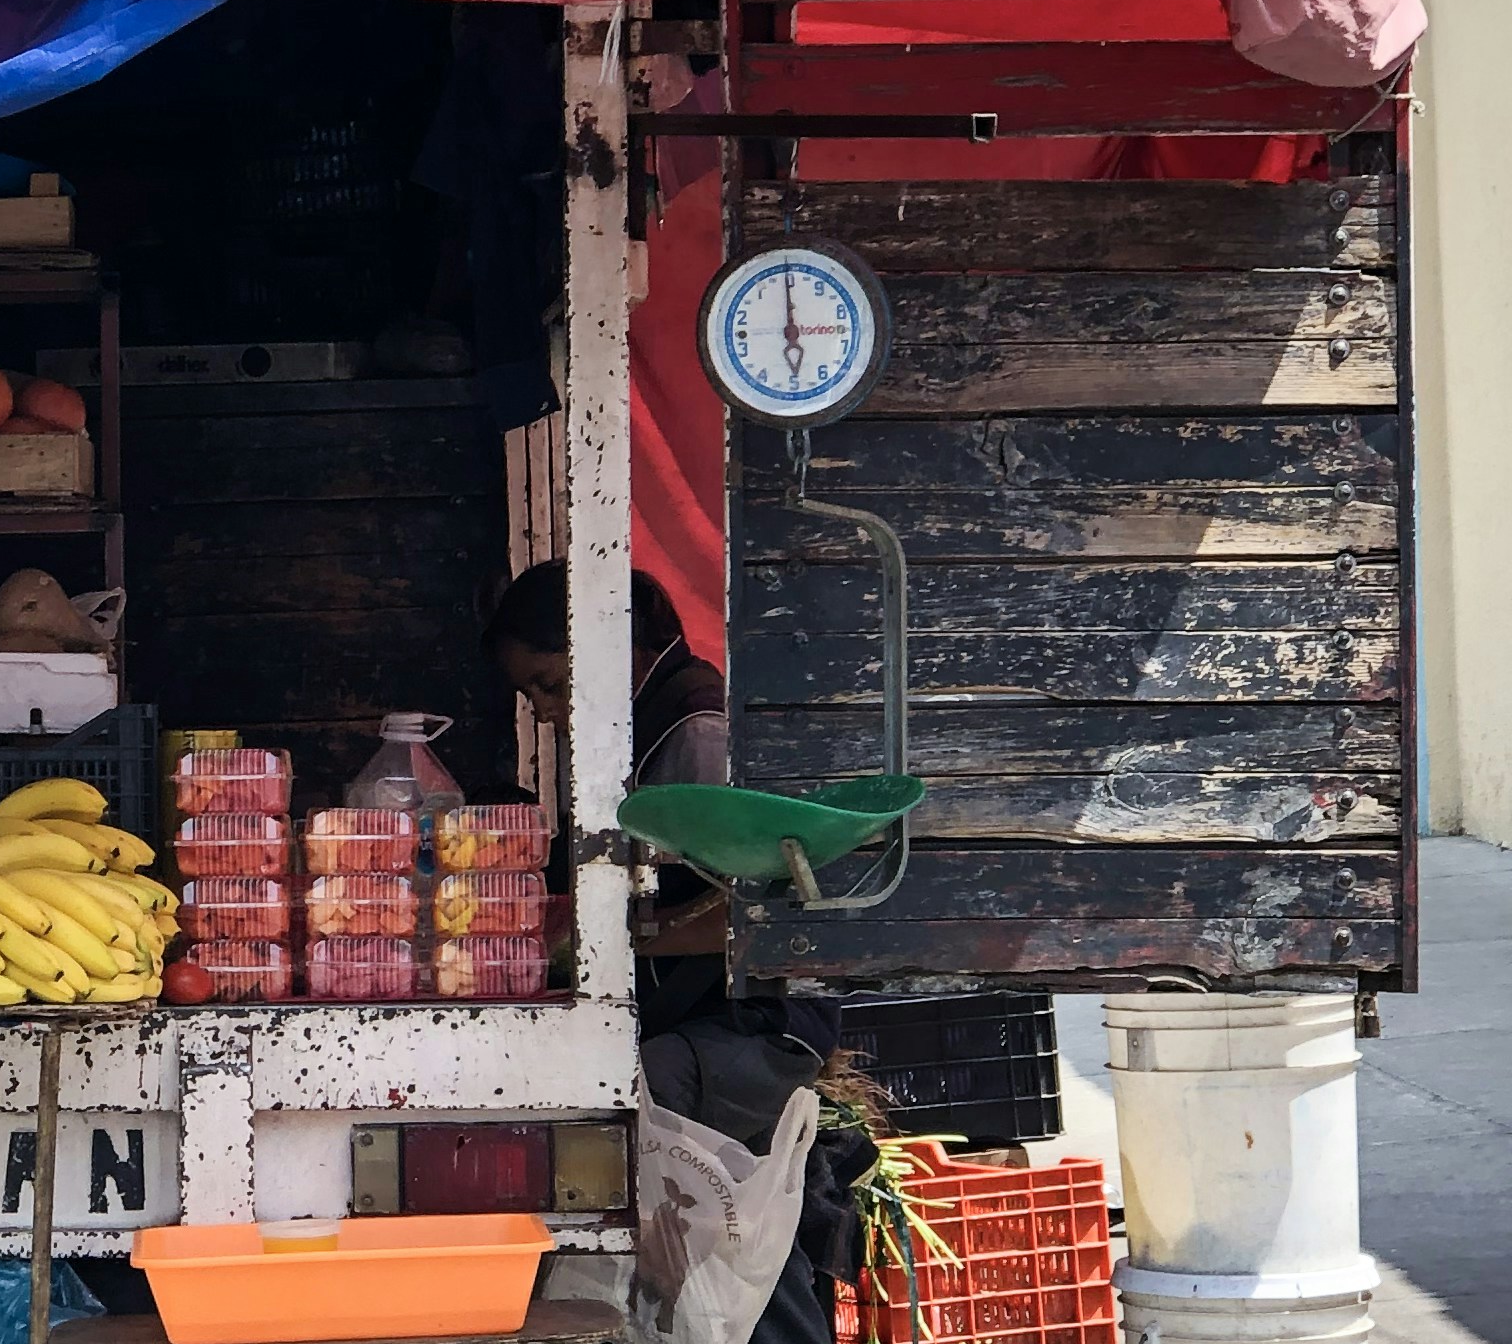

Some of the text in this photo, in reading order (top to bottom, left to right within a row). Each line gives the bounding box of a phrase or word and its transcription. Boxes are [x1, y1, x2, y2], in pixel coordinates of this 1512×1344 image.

[814, 281, 825, 296] 9
[737, 310, 748, 326] 2
[836, 304, 847, 320] 8
[800, 325, 836, 336] torino
[738, 342, 748, 357] 3
[840, 340, 850, 355] 7
[757, 367, 768, 383] 4
[818, 365, 828, 380] 6
[789, 374, 800, 391] 5
[669, 1145, 742, 1244] COMPOSTABLE
